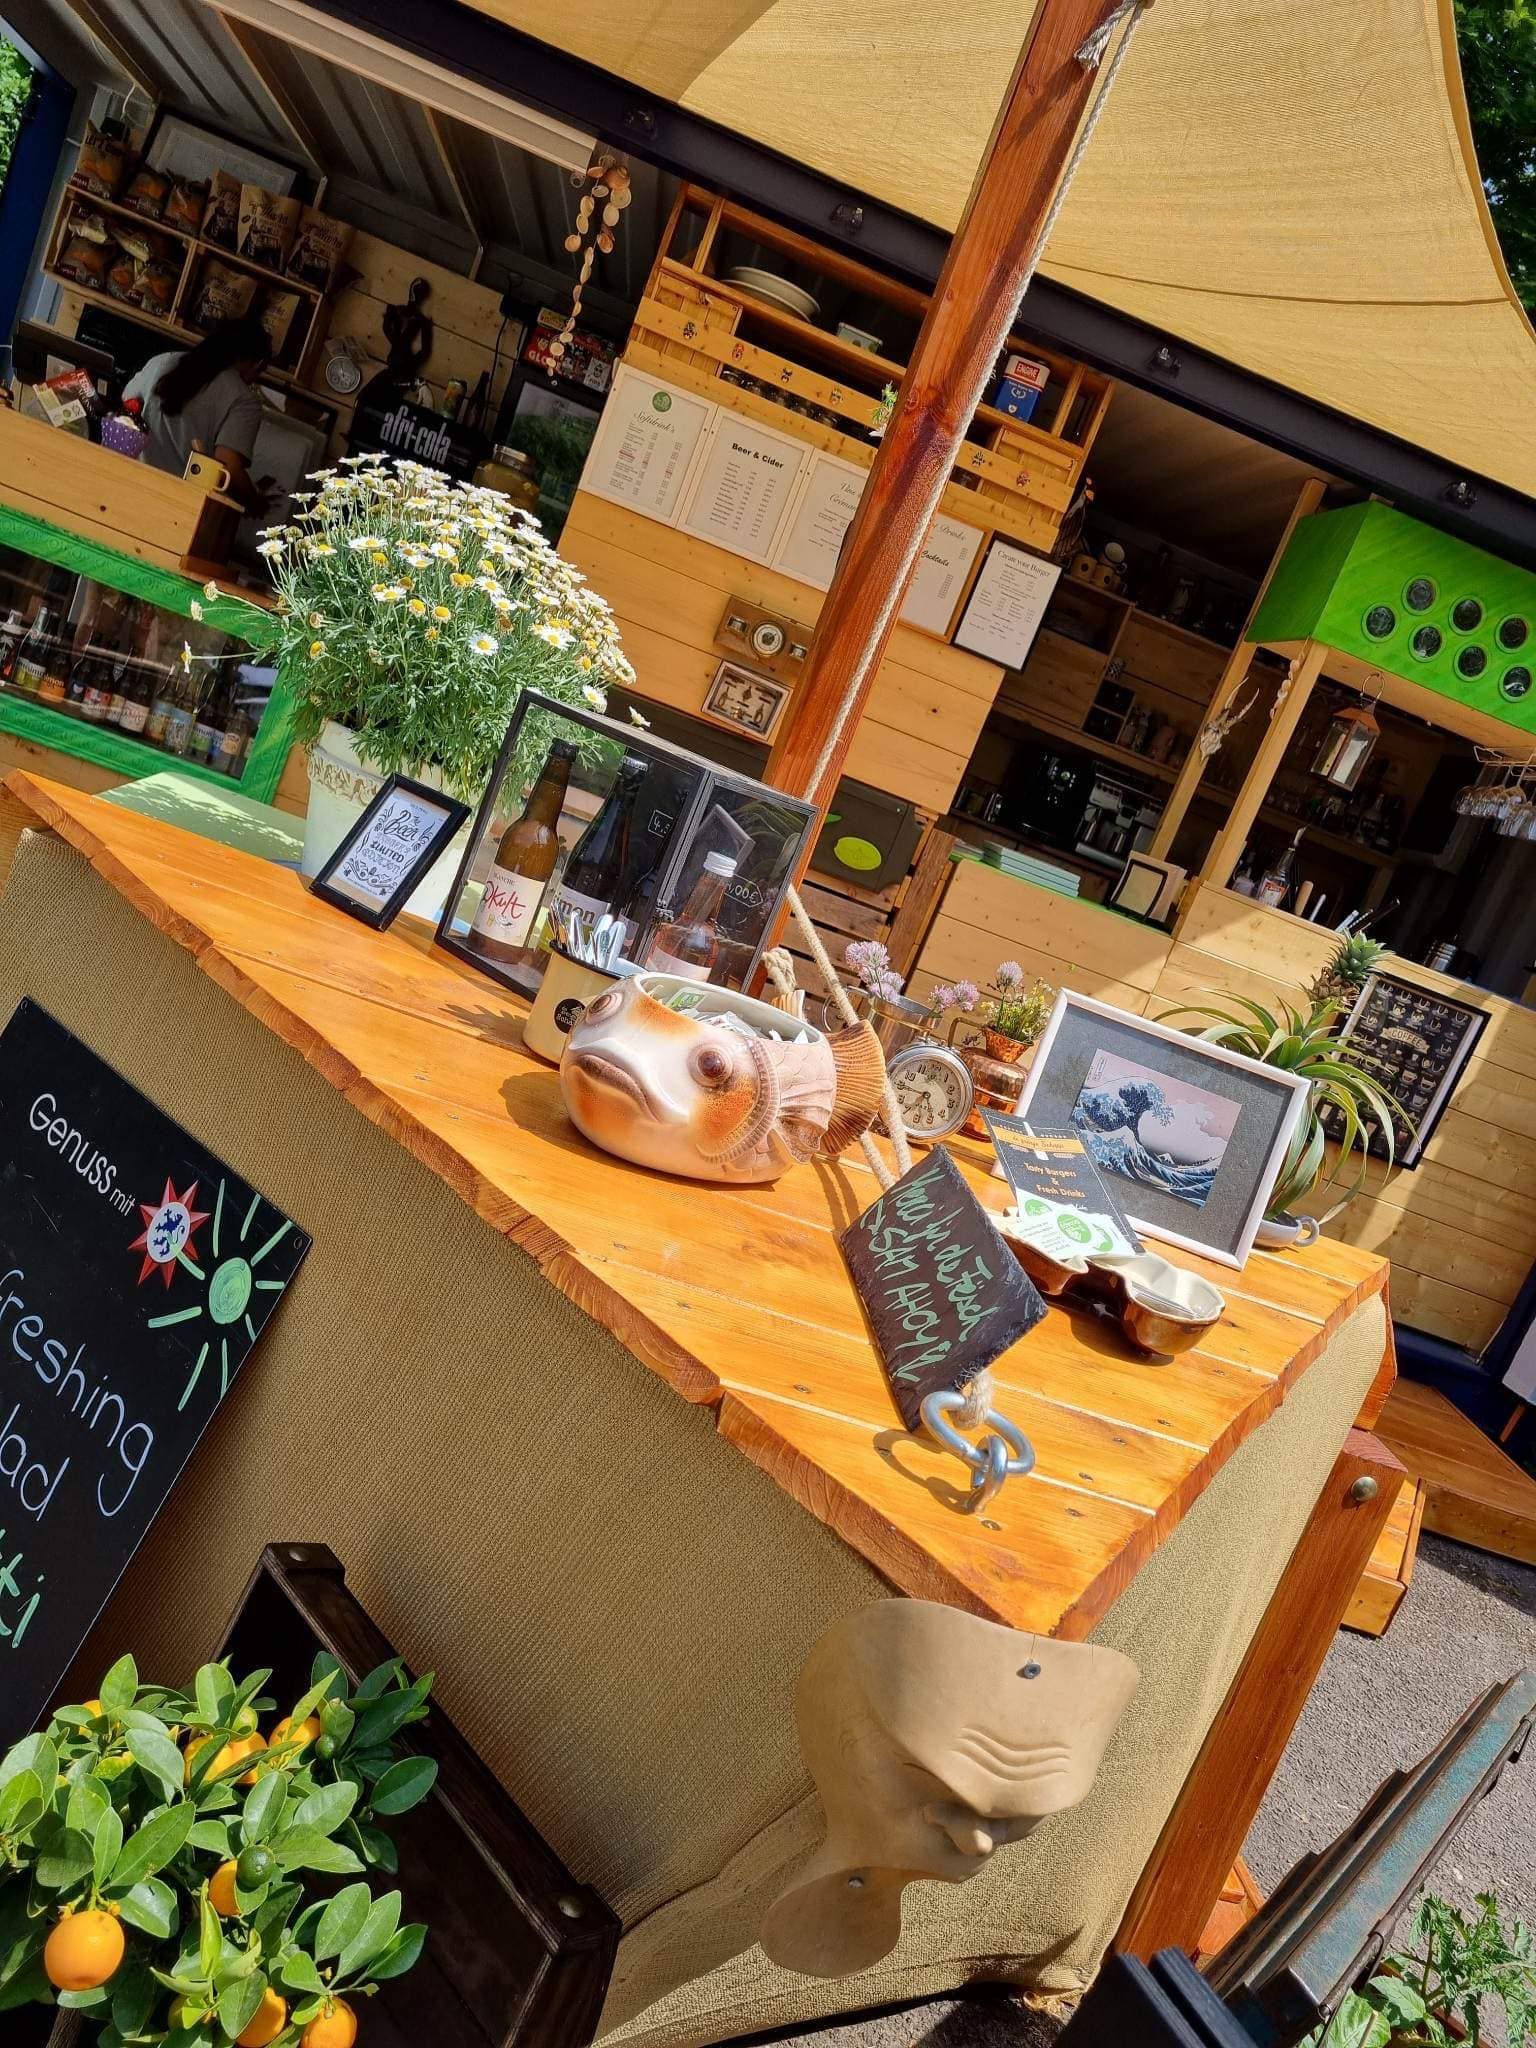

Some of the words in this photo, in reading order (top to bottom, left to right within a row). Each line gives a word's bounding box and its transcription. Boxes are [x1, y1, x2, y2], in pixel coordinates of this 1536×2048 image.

[380, 405, 451, 464] afri-cola
[732, 443, 751, 456] Beer
[762, 455, 784, 469] Cider
[920, 550, 950, 567] Cocktails
[997, 551, 1018, 563] Create
[1031, 561, 1051, 578] Burger
[383, 809, 418, 842] Beer
[370, 840, 405, 863] LIMITED
[1391, 1029, 1423, 1049] COFFEE
[29, 1093, 117, 1194] Genuss
[109, 1187, 136, 1217] mit
[1024, 1162, 1044, 1175] Tasty
[1045, 1167, 1077, 1178] Burgers
[1036, 1184, 1058, 1195] Fresh
[1060, 1188, 1086, 1198] Drinks
[883, 1282, 941, 1351] AHOY
